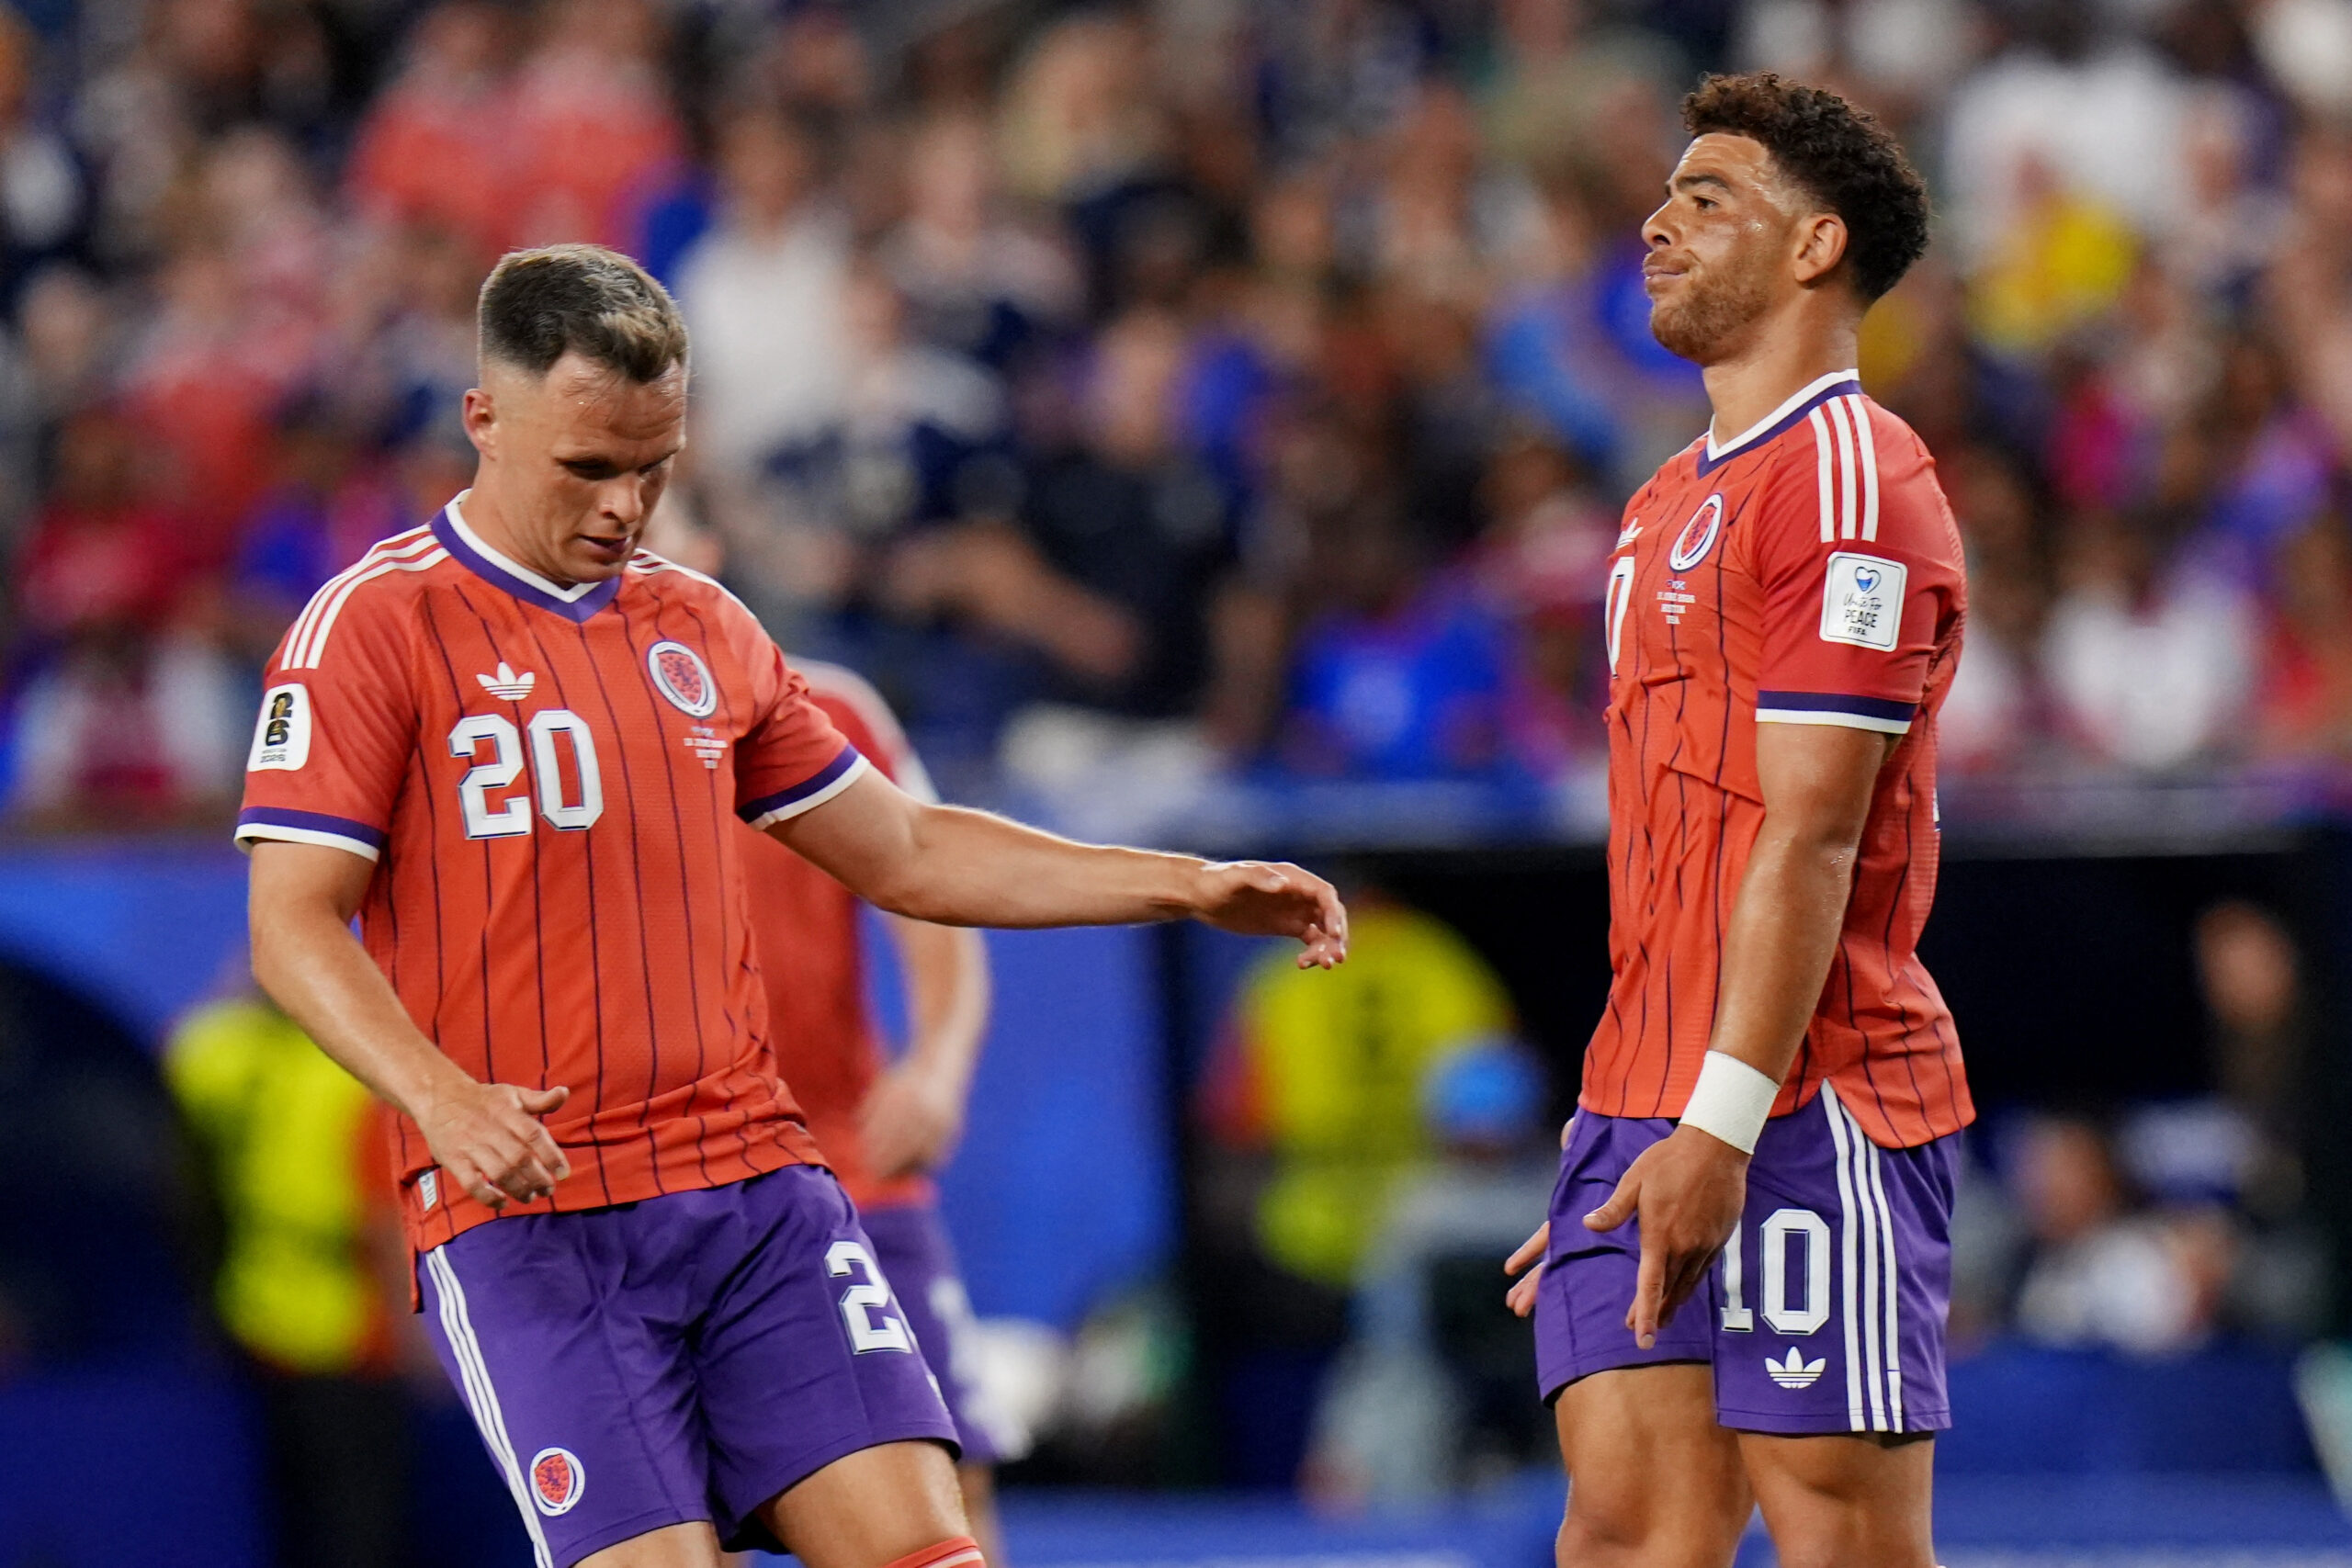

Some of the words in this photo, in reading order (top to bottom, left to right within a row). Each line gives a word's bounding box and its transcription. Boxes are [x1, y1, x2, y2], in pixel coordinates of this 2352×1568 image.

[1844, 609, 1878, 628] PEACE
[447, 709, 604, 840] 20
[824, 1241, 920, 1356] 2
[1720, 1208, 1830, 1336] 10
